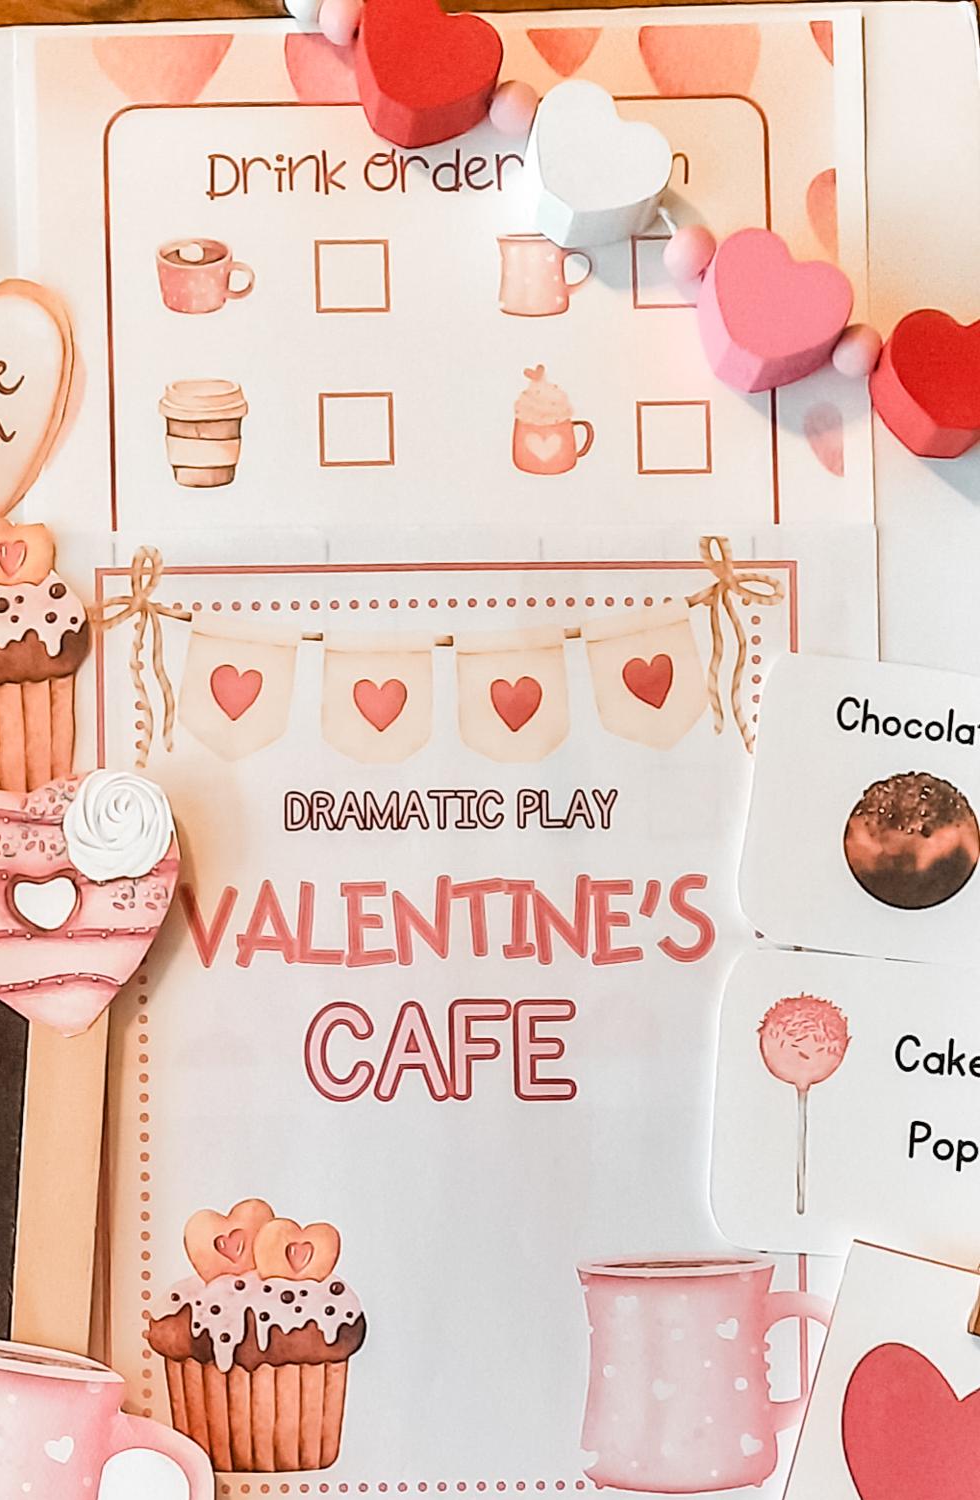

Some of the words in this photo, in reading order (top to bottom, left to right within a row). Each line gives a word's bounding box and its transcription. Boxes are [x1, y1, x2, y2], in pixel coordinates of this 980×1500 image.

[205, 149, 347, 201] Drink
[363, 148, 524, 194] Order
[836, 696, 980, 746] Chocola
[284, 789, 505, 832] DRAMATIC
[516, 788, 619, 830] PLAY
[179, 874, 716, 969] VALENTINE'S
[304, 998, 578, 1103] CAFE
[908, 1120, 979, 1172] Pop
